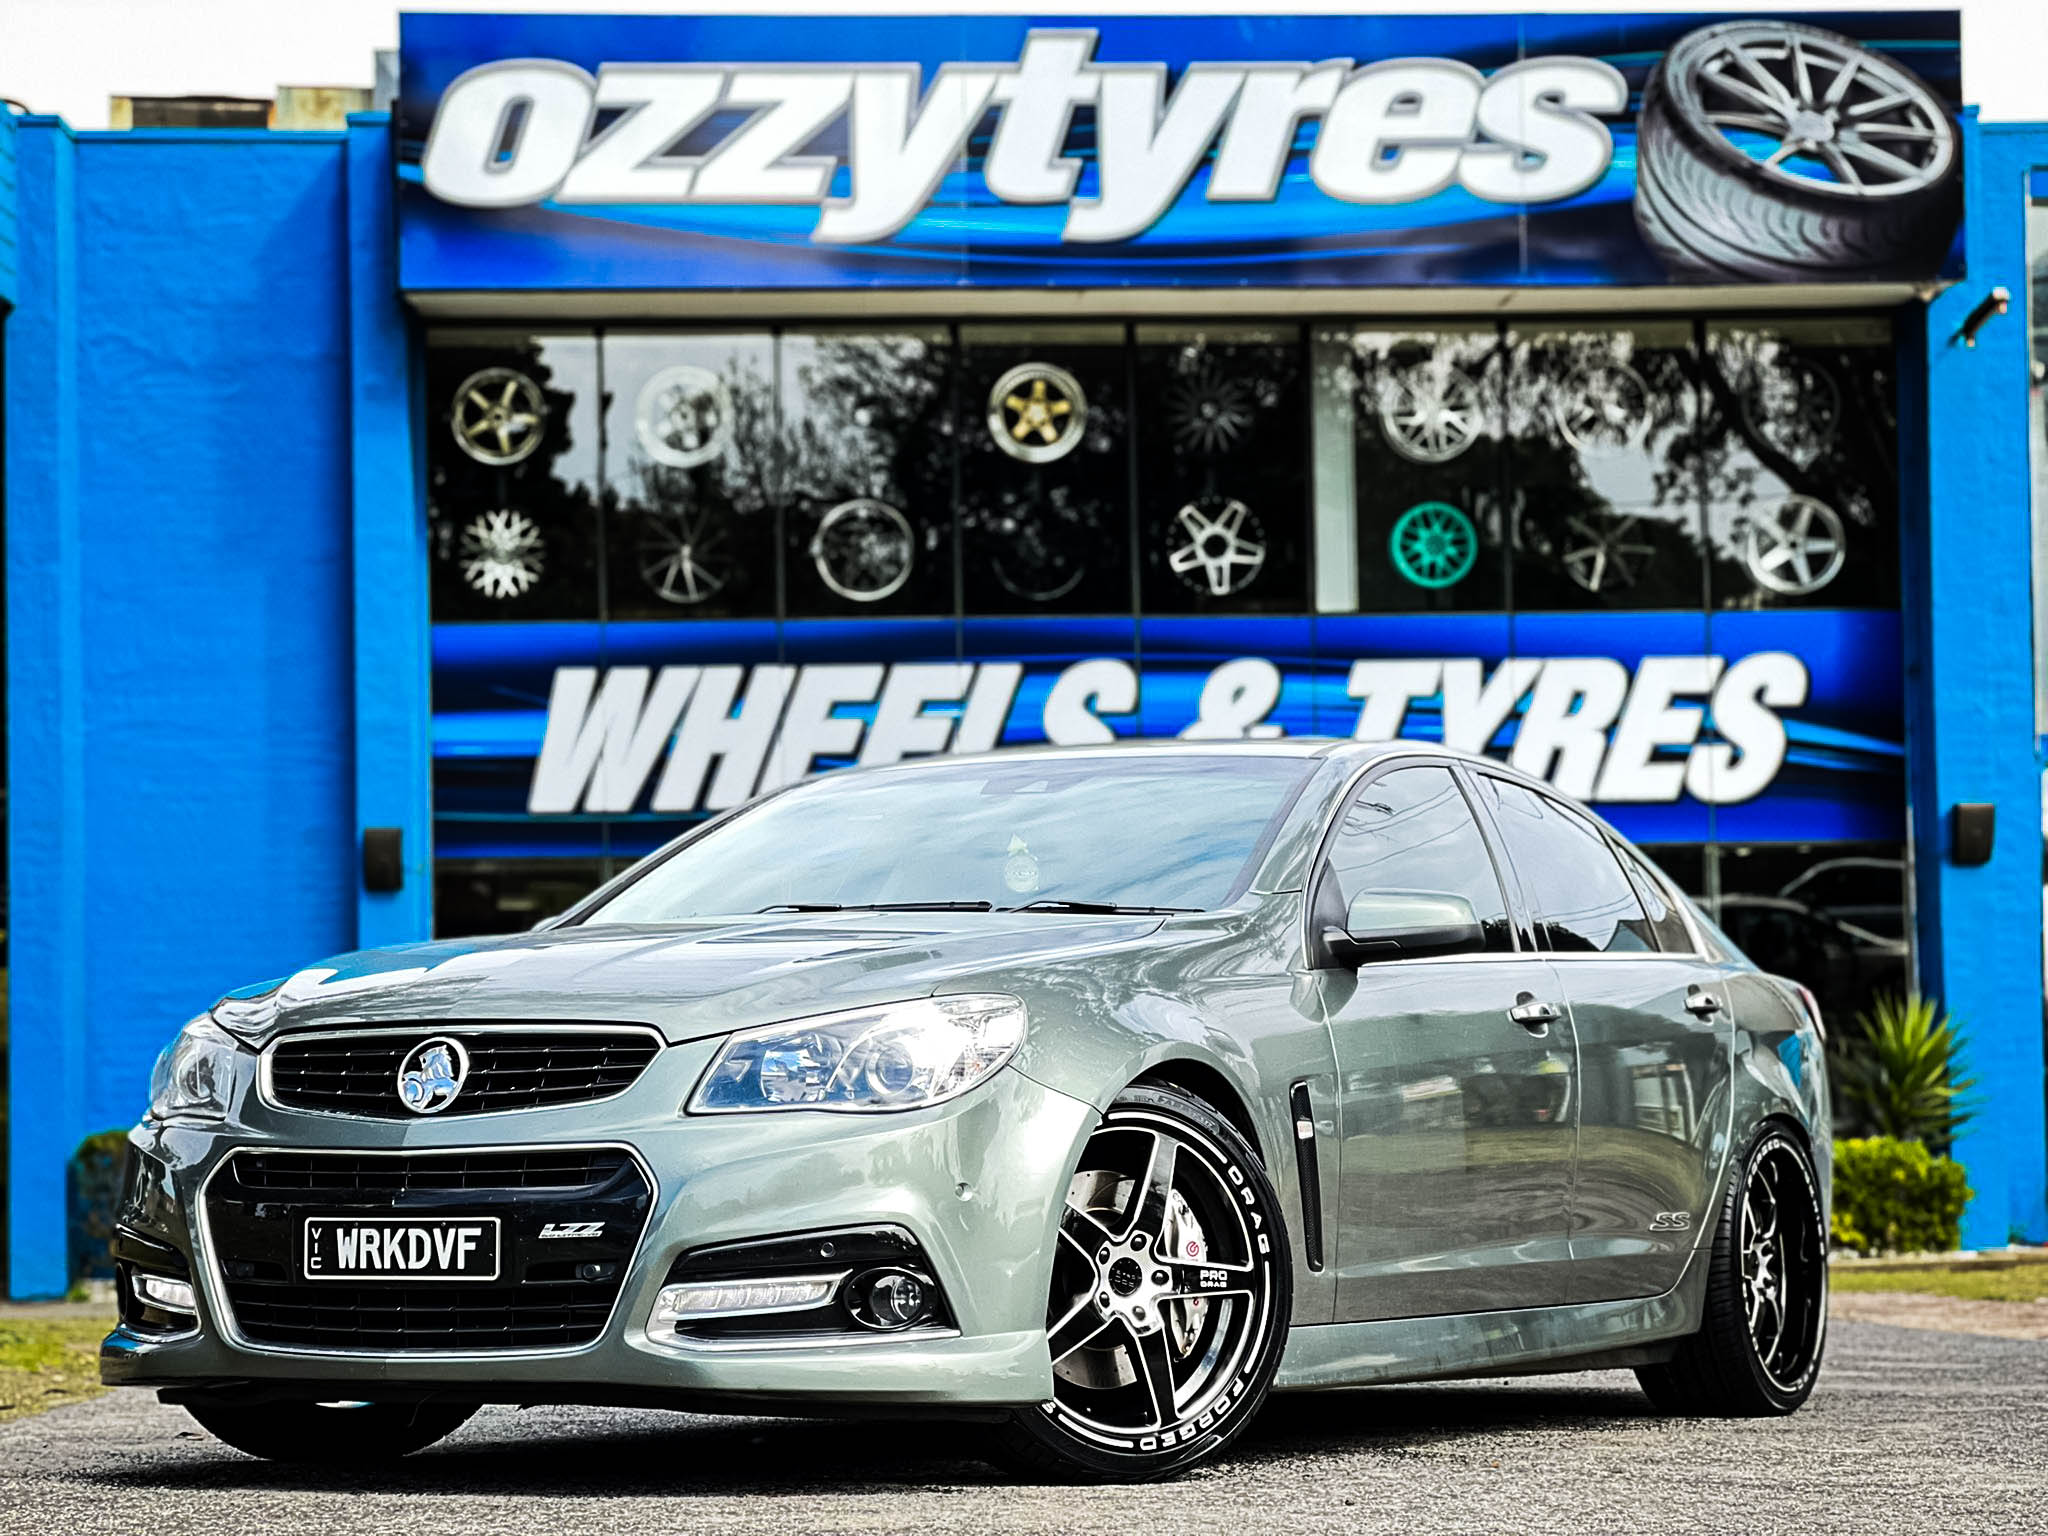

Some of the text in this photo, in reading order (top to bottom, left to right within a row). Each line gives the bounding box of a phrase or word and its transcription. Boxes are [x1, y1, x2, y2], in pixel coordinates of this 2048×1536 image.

[421, 27, 1629, 245] ozzytyres
[527, 657, 1140, 815] WHEELS
[1346, 651, 1809, 805] TYRES
[1227, 1164, 1271, 1255] DRAG
[1649, 1211, 1690, 1232] SS
[310, 1227, 322, 1270] VIC
[336, 1227, 482, 1270] WRKDVF
[1200, 1269, 1228, 1281] PRO
[1139, 1376, 1245, 1452] FORGED
